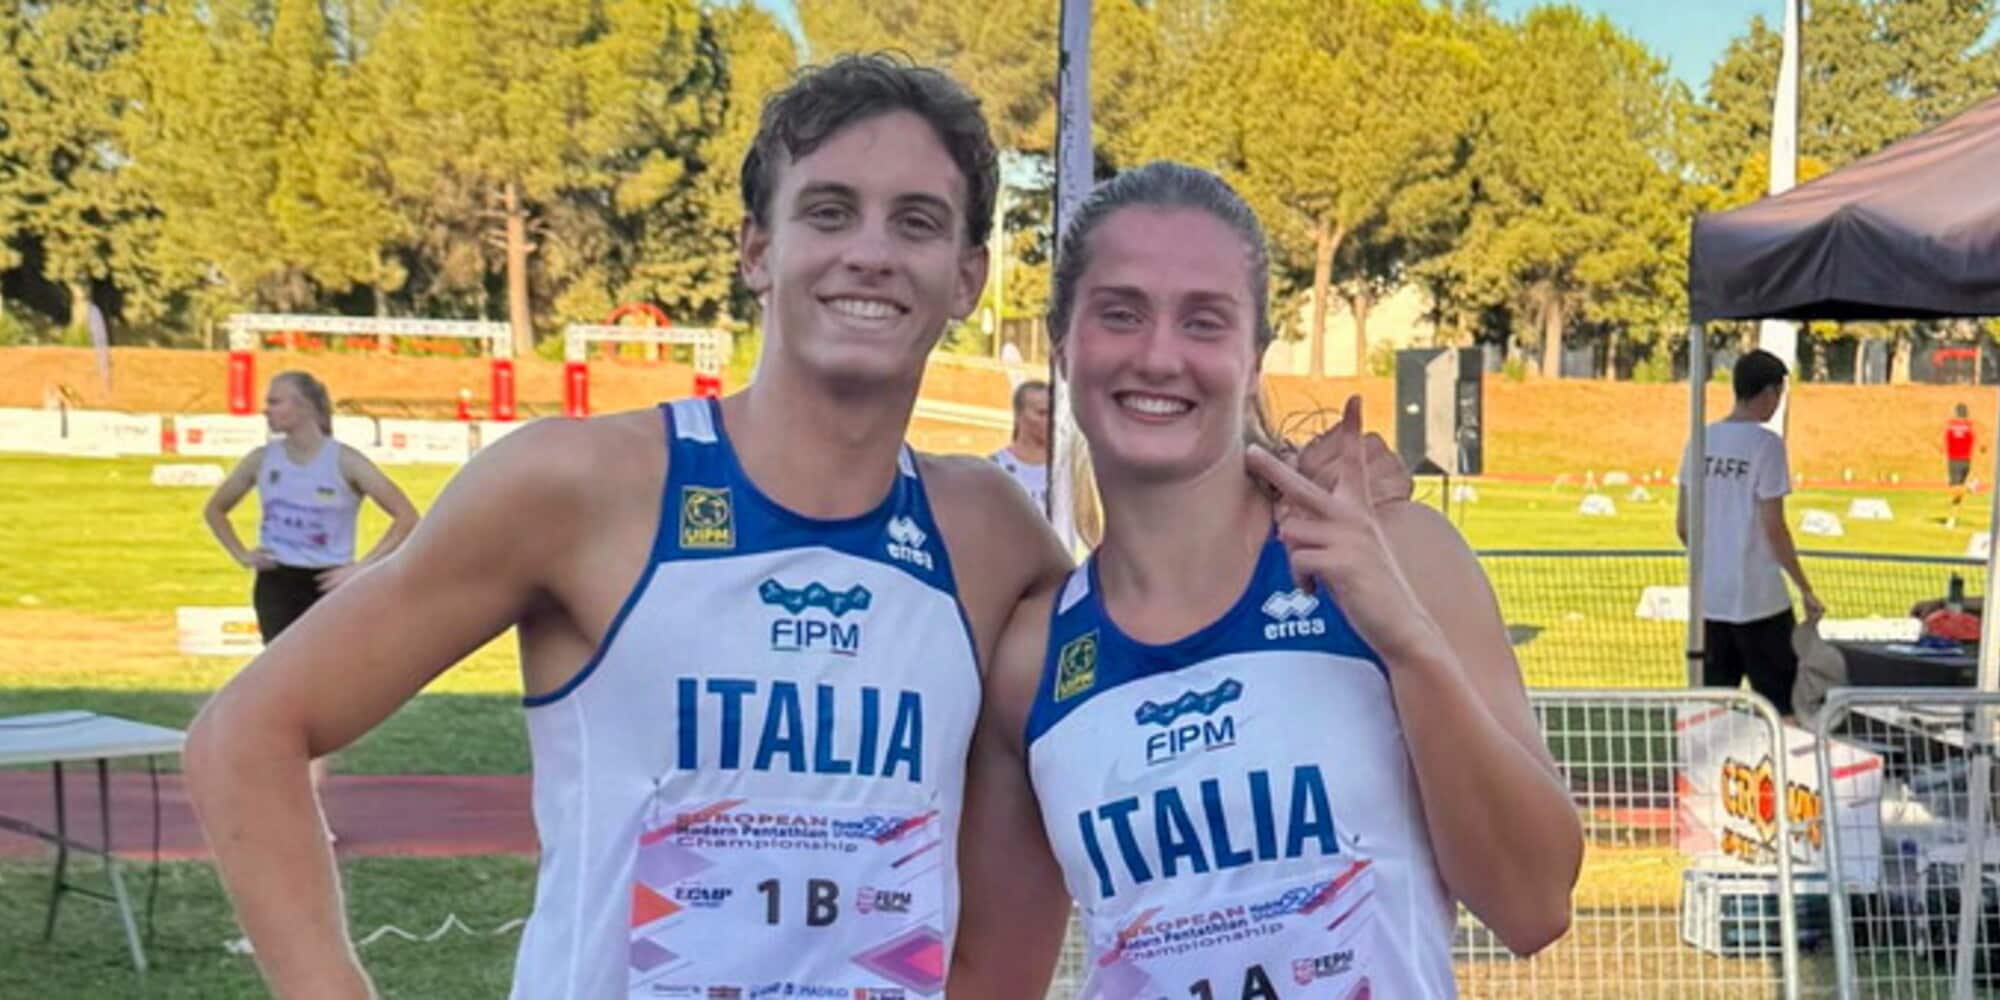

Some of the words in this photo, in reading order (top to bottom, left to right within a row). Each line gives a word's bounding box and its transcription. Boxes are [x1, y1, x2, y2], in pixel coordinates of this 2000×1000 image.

[1705, 456, 1750, 479] TAFF
[771, 619, 860, 650] FIPM
[677, 677, 923, 782] ITALIA
[1146, 715, 1236, 760] FIPM
[676, 813, 828, 826] EUROPEAN
[676, 824, 739, 836] Modern
[741, 824, 828, 838] Pentathlon
[1078, 765, 1340, 899] ITALIA
[677, 837, 859, 853] Championship
[757, 878, 780, 925] 1
[806, 879, 839, 926] B
[1120, 922, 1284, 960] Championship
[1164, 918, 1249, 944] Pentathlon
[1240, 963, 1282, 1000] A
